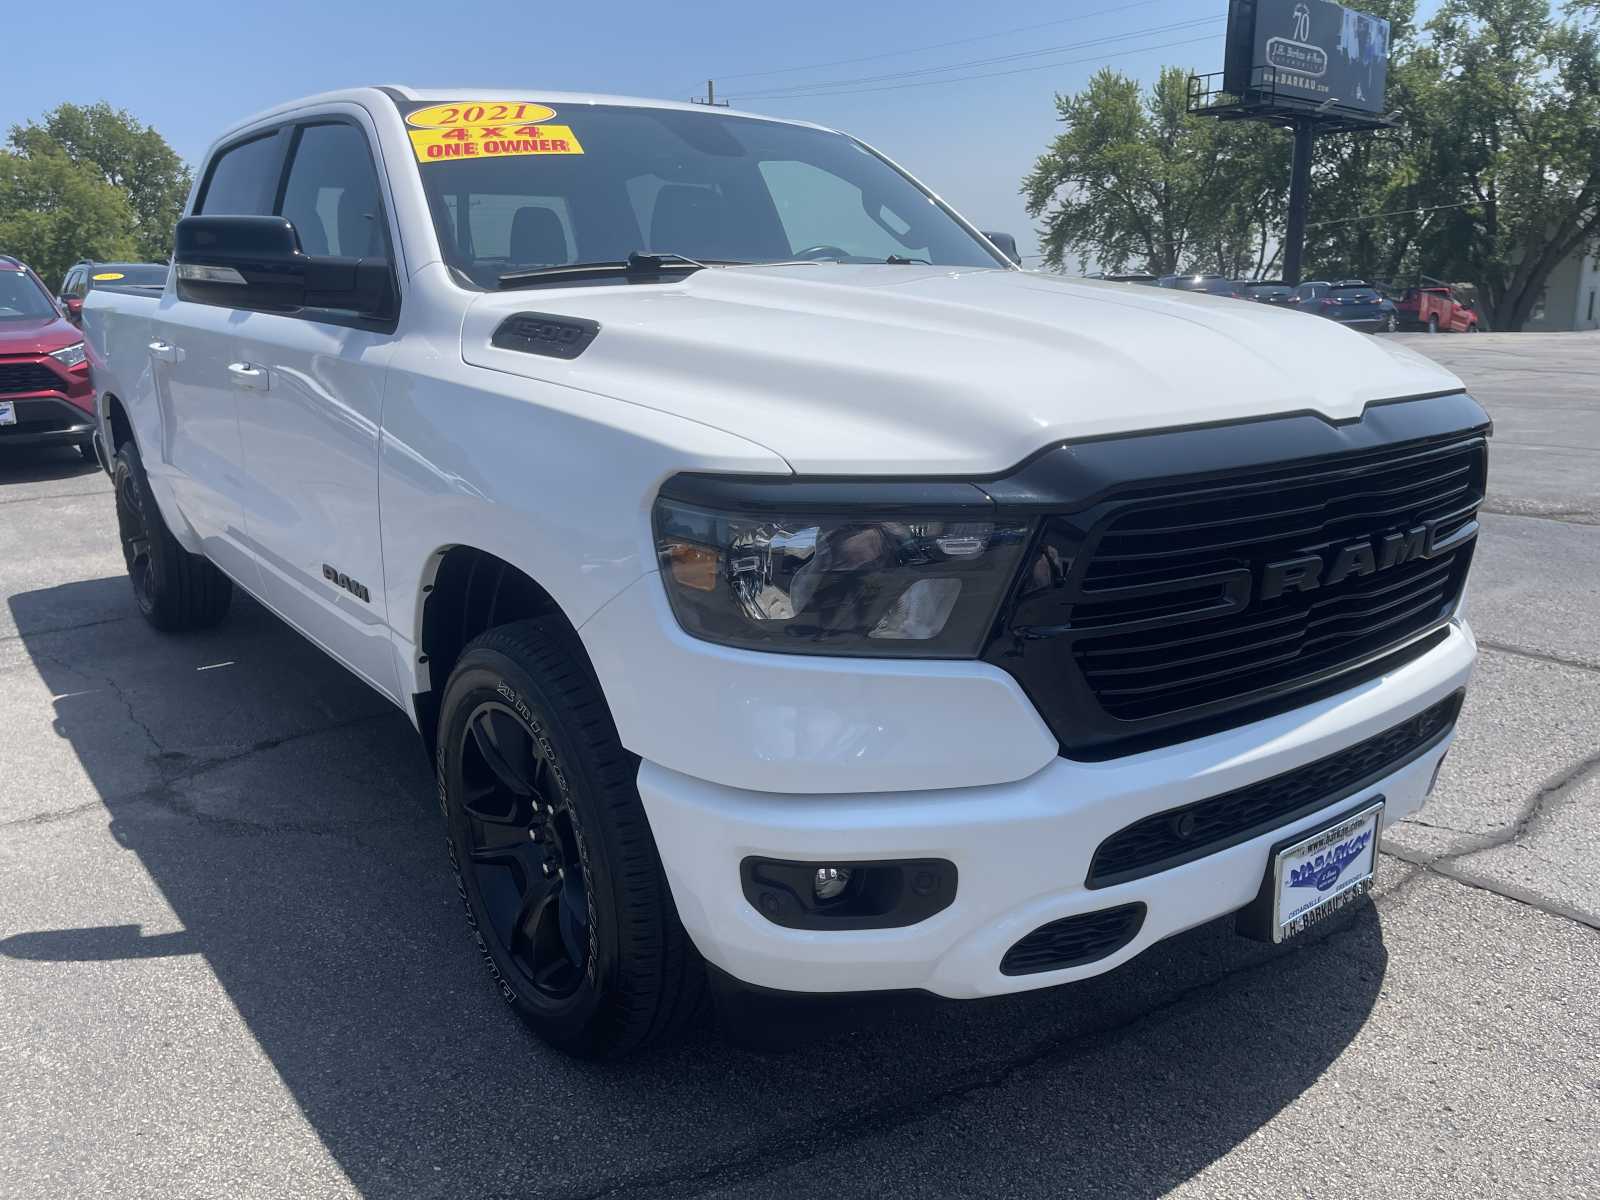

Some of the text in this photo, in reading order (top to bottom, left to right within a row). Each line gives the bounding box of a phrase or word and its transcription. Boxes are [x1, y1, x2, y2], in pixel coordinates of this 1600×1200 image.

[1293, 12, 1310, 42] 70
[439, 104, 528, 125] 2021
[427, 139, 570, 158] ONE OWNER
[1260, 525, 1427, 601] RAM
[322, 563, 370, 603] RAM
[1302, 893, 1340, 928] BARKAU
